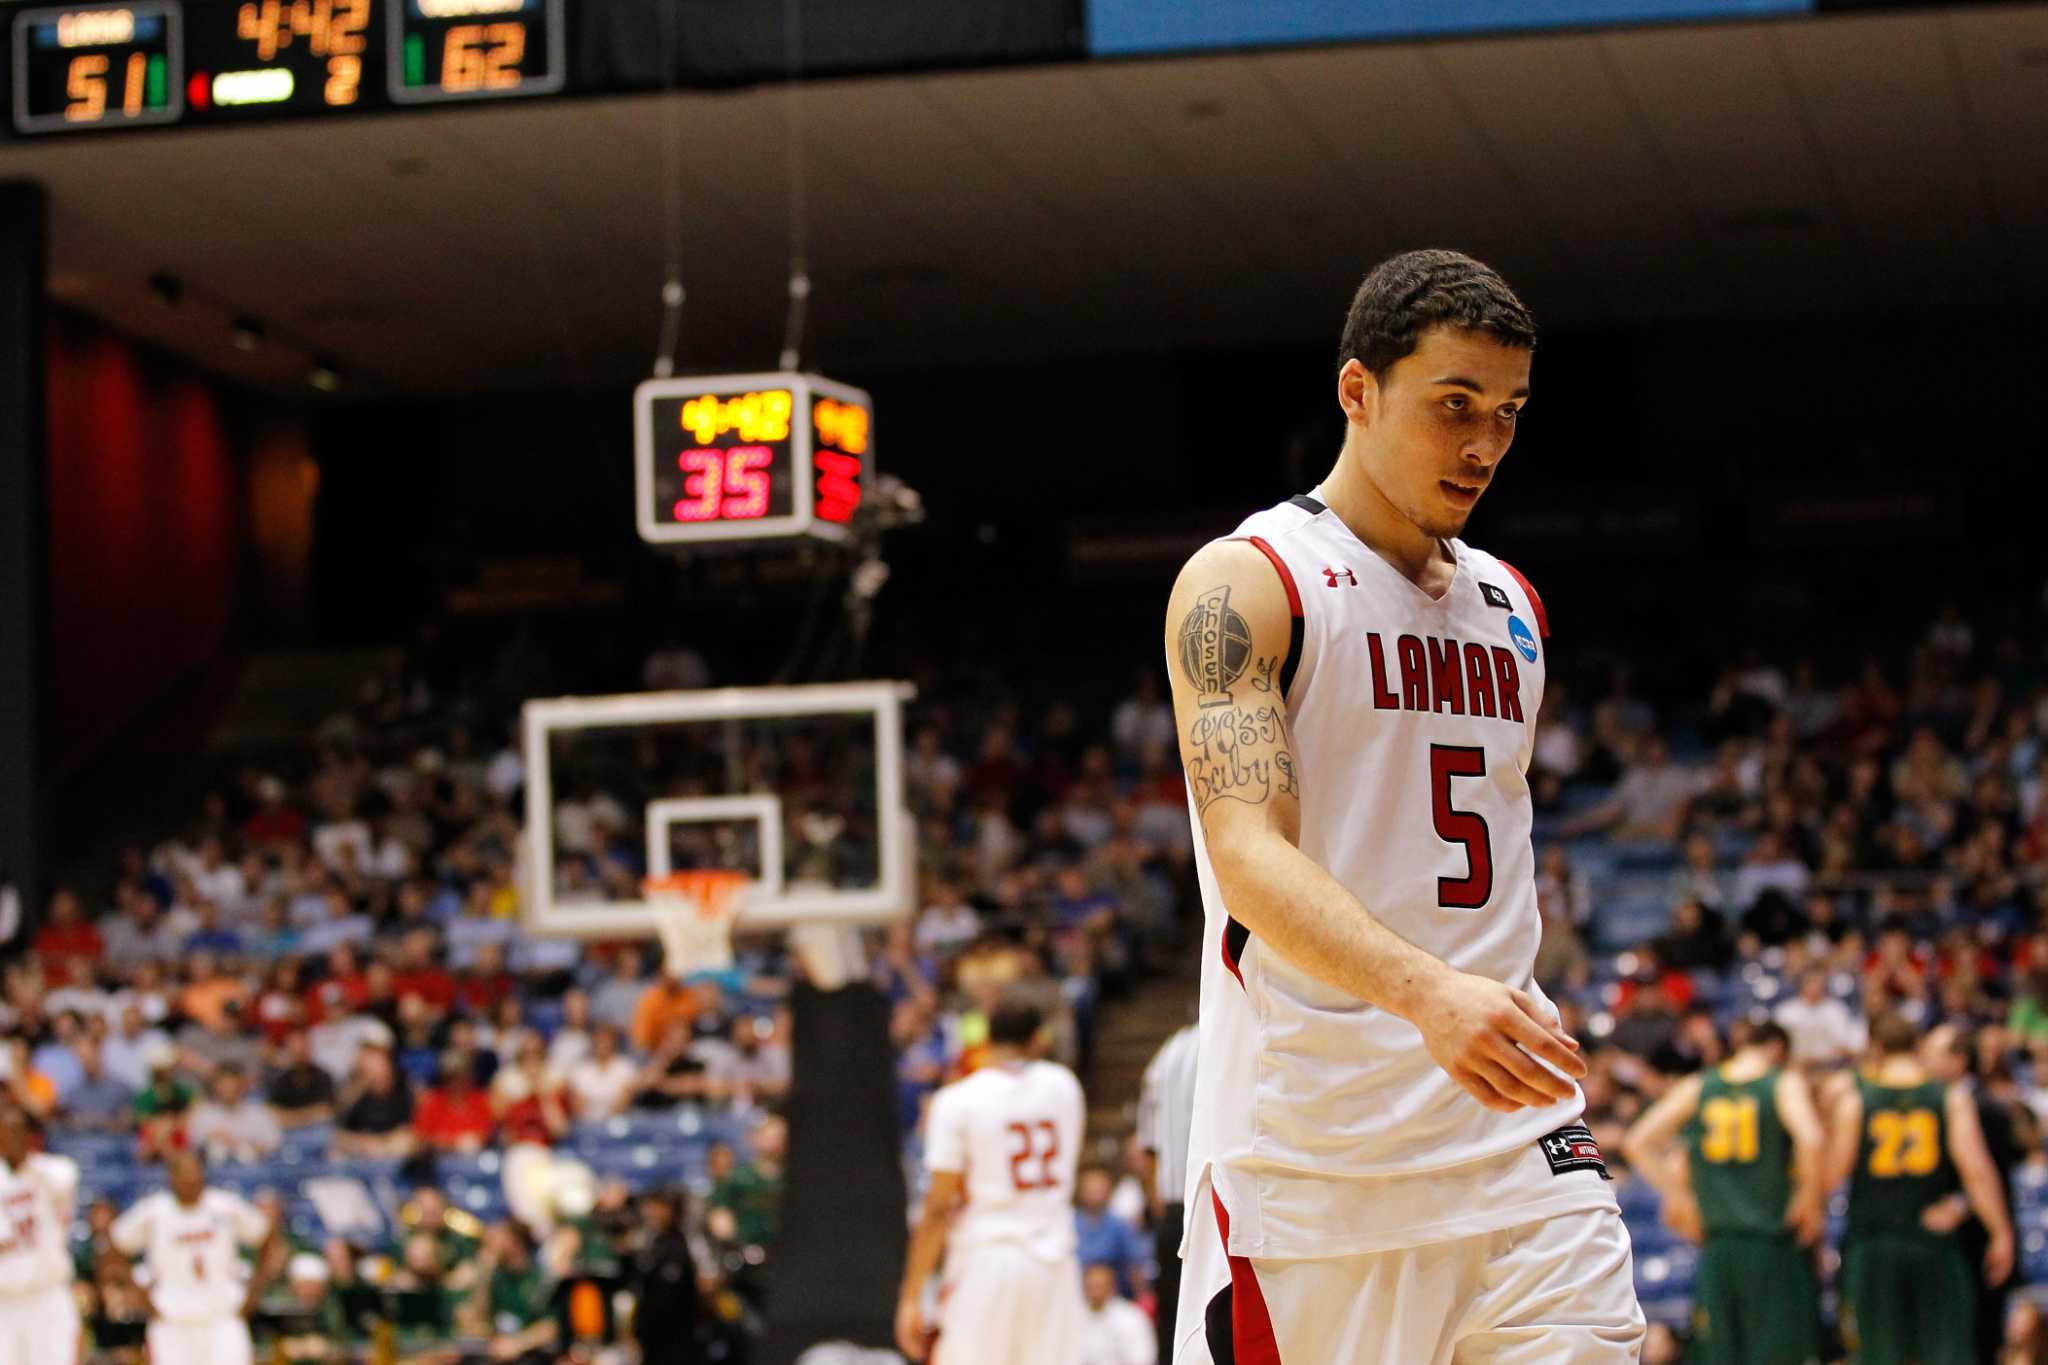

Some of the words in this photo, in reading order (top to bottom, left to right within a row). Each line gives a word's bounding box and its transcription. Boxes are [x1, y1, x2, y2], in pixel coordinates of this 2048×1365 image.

[237, 0, 371, 60] 4:42
[441, 22, 526, 92] 62
[64, 51, 147, 122] 51
[673, 445, 773, 522] 35
[1366, 632, 1525, 724] LAMAR
[1429, 742, 1494, 910] 5
[1008, 1120, 1060, 1191] 22
[1703, 1095, 1758, 1163] 31
[1869, 1108, 1940, 1176] 23
